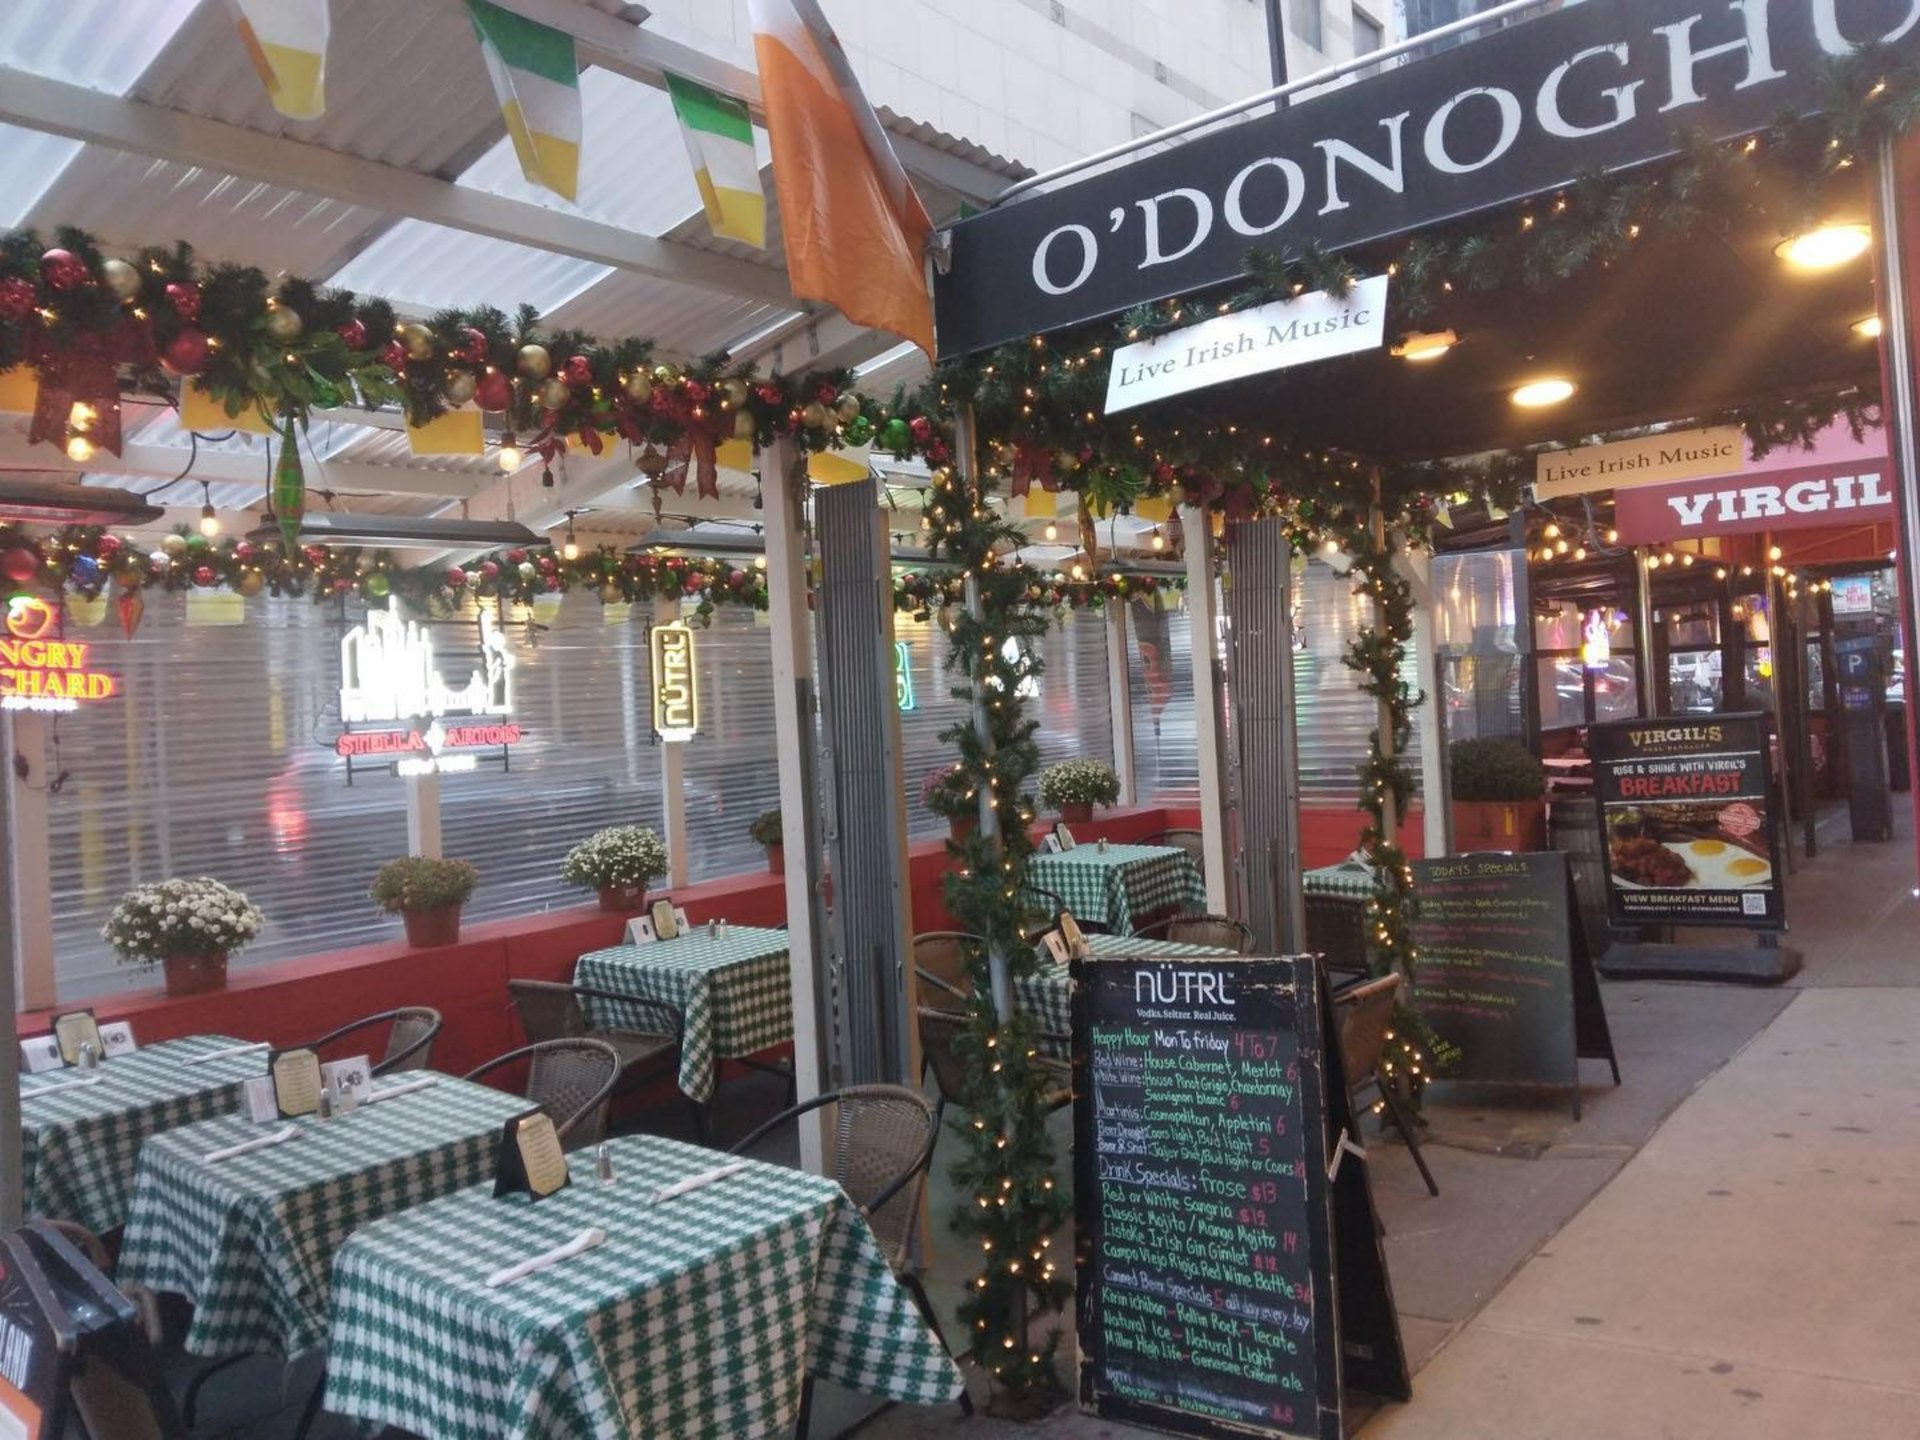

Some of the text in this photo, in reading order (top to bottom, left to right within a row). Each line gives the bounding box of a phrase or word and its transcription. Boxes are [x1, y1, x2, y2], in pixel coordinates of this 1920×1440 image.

[1118, 308, 1371, 388] Live Irish Music
[1545, 442, 1733, 482] Live Irish Music
[1667, 473, 1892, 526] VIRGIL
[1848, 654, 1862, 673] P
[337, 724, 521, 756] STELLA ARTOIS
[1629, 726, 1722, 747] VIRGIL'S
[1613, 759, 1746, 776] RISE & SHINE WITH VIRGIL'S
[1620, 771, 1741, 797] BREAKFAST
[1623, 895, 1738, 904] VIEW BREAKFAST MENU
[1193, 1010, 1212, 1020] Real
[1093, 1026, 1123, 1051] Happy
[1125, 1027, 1150, 1047] Hour
[1154, 1029, 1177, 1048] Mon
[1177, 1030, 1191, 1050] To
[1235, 1032, 1244, 1057] 4
[1266, 1034, 1278, 1058] 7
[1094, 1050, 1112, 1067] Red
[1144, 1050, 1176, 1068] House
[1241, 1059, 1282, 1079] Merlot
[1287, 1062, 1297, 1080] 6
[1144, 1070, 1174, 1087] House
[1175, 1072, 1200, 1091] Pinot
[1230, 1093, 1240, 1110] 6
[1218, 1112, 1272, 1136] Appletini
[1276, 1114, 1286, 1136] 6
[1196, 1129, 1220, 1149] Bud
[1258, 1137, 1270, 1155] 5
[1098, 1155, 1135, 1181] Drink
[1252, 1161, 1263, 1171] or
[1265, 1158, 1295, 1177] Coors
[1102, 1181, 1126, 1202] Red
[1128, 1191, 1141, 1203] or
[1143, 1190, 1180, 1210] White
[1184, 1195, 1233, 1221] Sangria
[1102, 1203, 1146, 1225] Classic
[1148, 1209, 1187, 1234] Mojito
[1198, 1217, 1235, 1247] Mango
[1236, 1223, 1277, 1251] Mojito
[1148, 1227, 1183, 1252] Irish
[1186, 1236, 1206, 1258] Gin
[1208, 1240, 1248, 1267] Gimlet
[1200, 1260, 1222, 1280] Red
[1213, 1288, 1224, 1309] 5
[1225, 1292, 1240, 1311] all
[1103, 1308, 1275, 1371] Natural Ice Natural Light
[1243, 1321, 1298, 1355] Tecate
[1281, 1370, 1304, 1393] ale
